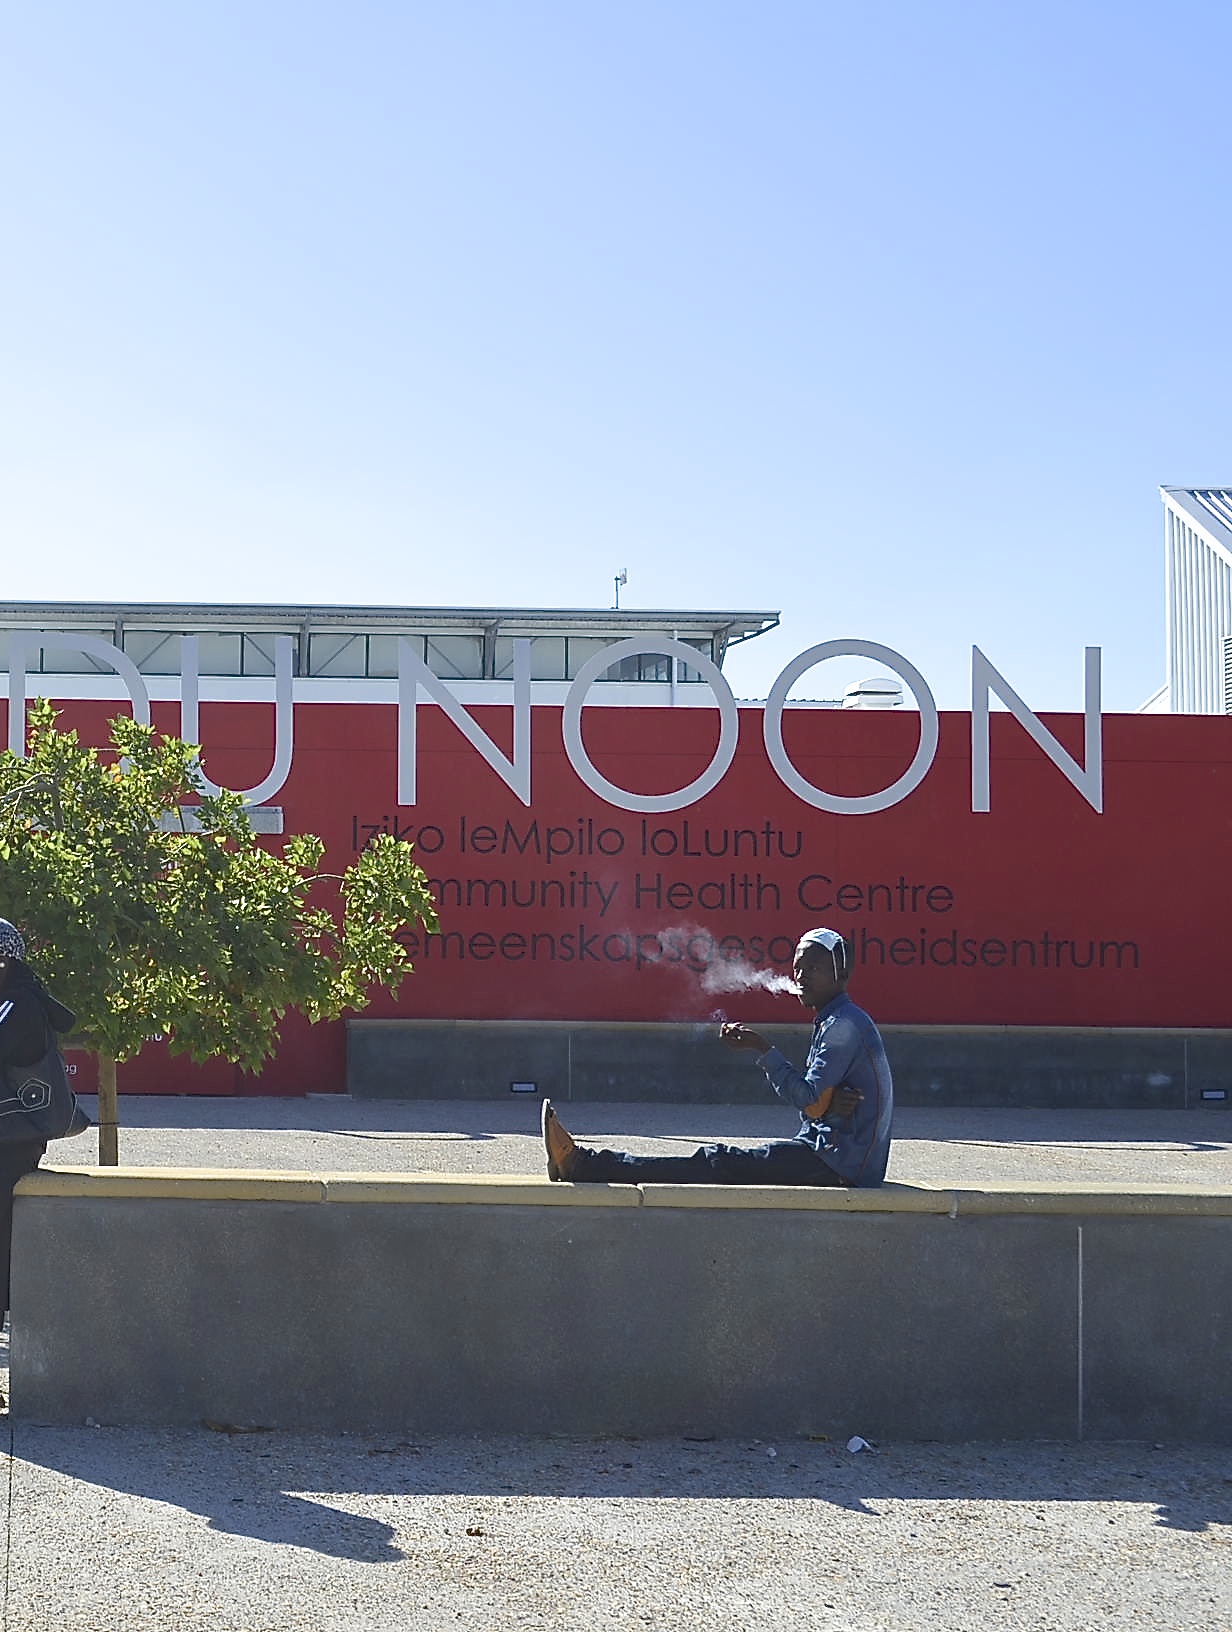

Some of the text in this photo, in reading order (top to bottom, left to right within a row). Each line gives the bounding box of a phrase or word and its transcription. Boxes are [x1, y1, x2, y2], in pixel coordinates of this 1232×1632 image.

[8, 630, 1104, 815] DU NOON
[460, 817, 625, 864] leMpilo
[641, 820, 803, 859] loLuntu
[423, 872, 955, 918] mmunity Health Centre
[394, 924, 1140, 973] emeenskapsgesoheidsentrum
